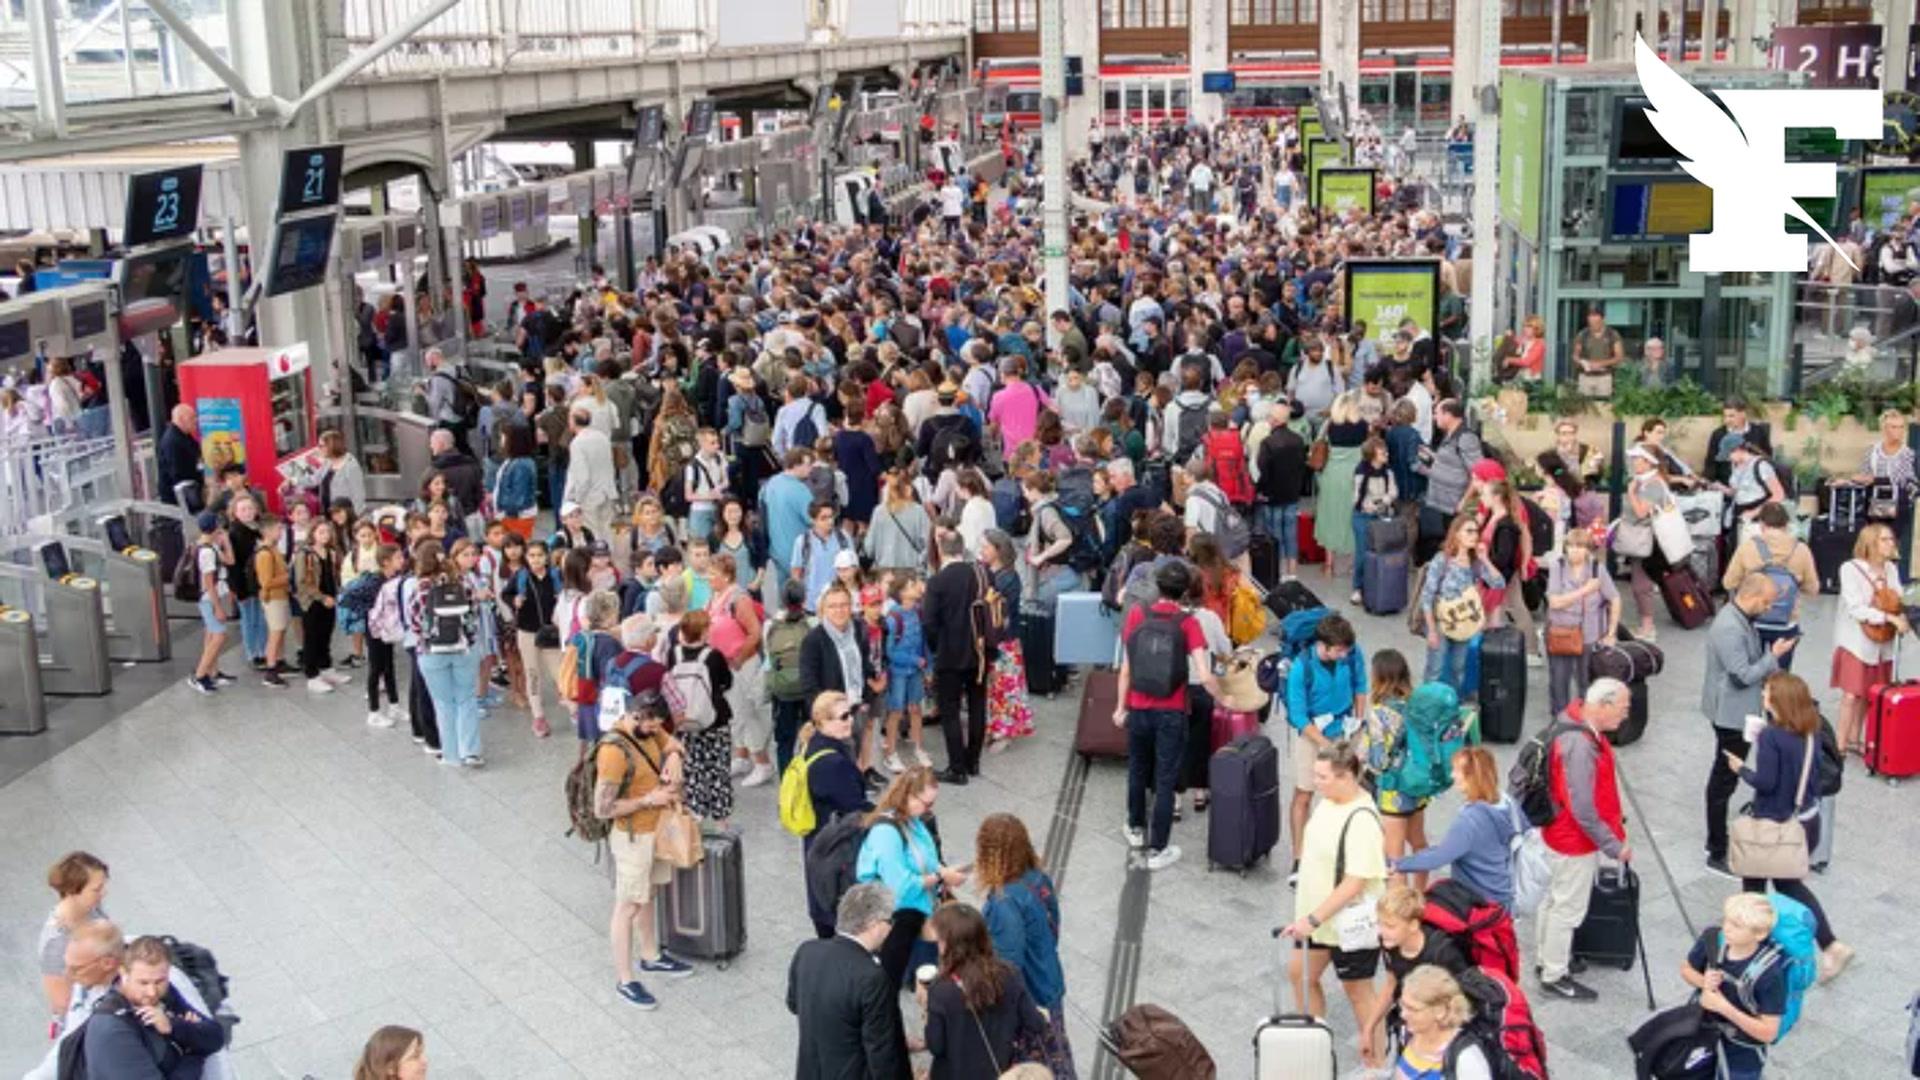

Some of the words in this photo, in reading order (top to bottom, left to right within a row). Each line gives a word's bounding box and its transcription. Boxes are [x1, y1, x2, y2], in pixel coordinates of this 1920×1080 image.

[1798, 44, 1818, 77] 2
[304, 168, 324, 196] 21
[155, 193, 178, 225] 23
